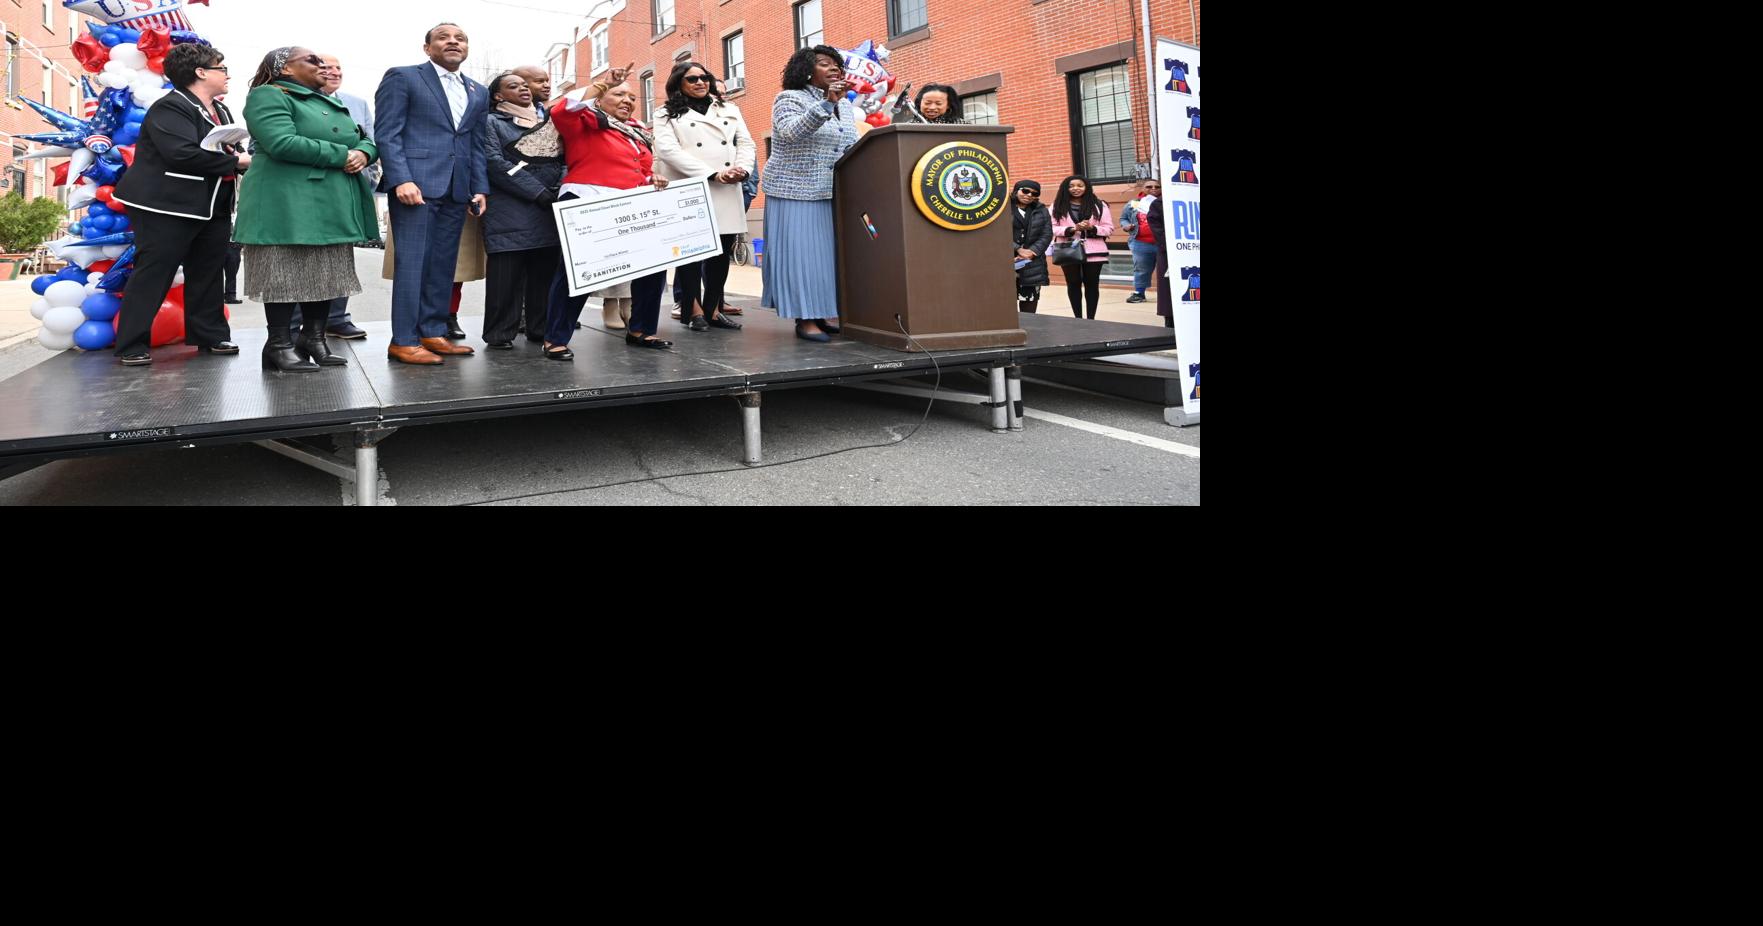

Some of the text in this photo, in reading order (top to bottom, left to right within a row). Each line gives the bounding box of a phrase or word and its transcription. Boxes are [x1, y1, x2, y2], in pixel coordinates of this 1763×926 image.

[926, 149, 1004, 187] MAYOR OF PHILADELPHIA
[929, 194, 963, 220] CHERELLE
[975, 197, 1000, 218] PARKER
[614, 215, 631, 224] 1300
[632, 213, 639, 221] S.
[630, 222, 656, 232] Thousand
[1176, 242, 1192, 250] ONE
[593, 263, 631, 278] SANITATION
[118, 428, 170, 439] SMARTSTAGE
